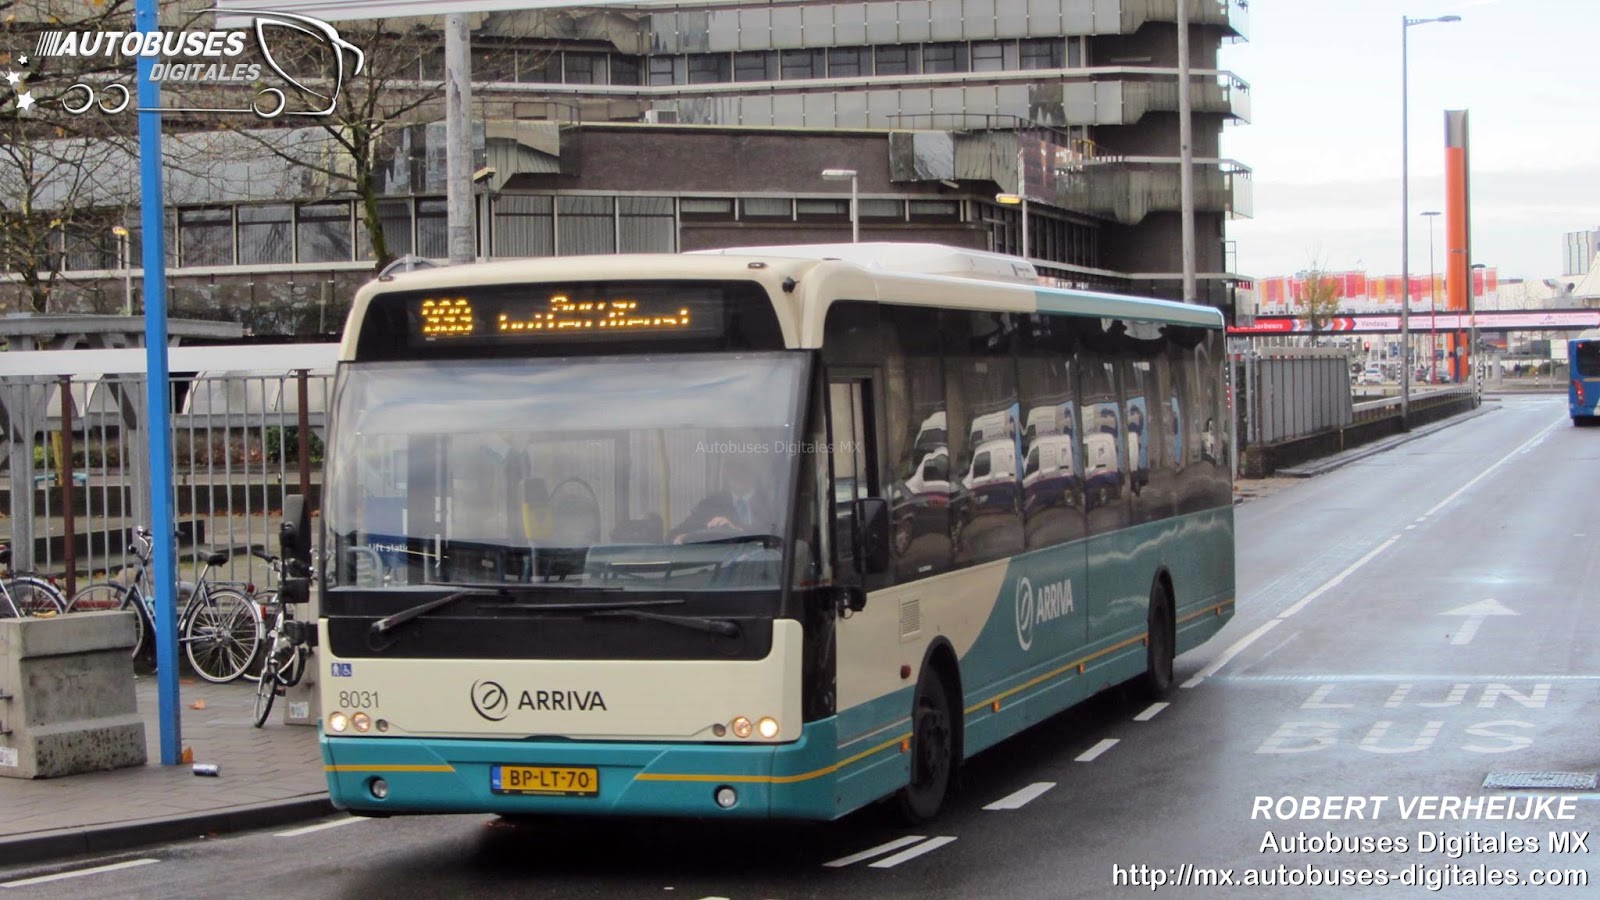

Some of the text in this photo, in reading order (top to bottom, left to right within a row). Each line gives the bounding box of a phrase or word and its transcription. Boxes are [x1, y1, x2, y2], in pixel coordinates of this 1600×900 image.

[1036, 579, 1075, 624] ARRIVA
[339, 691, 379, 708] 8031
[517, 690, 608, 712] ARRIVA
[1299, 684, 1552, 709] LIJN
[1255, 720, 1536, 754] BUS
[510, 769, 590, 788] BP-LT-70
